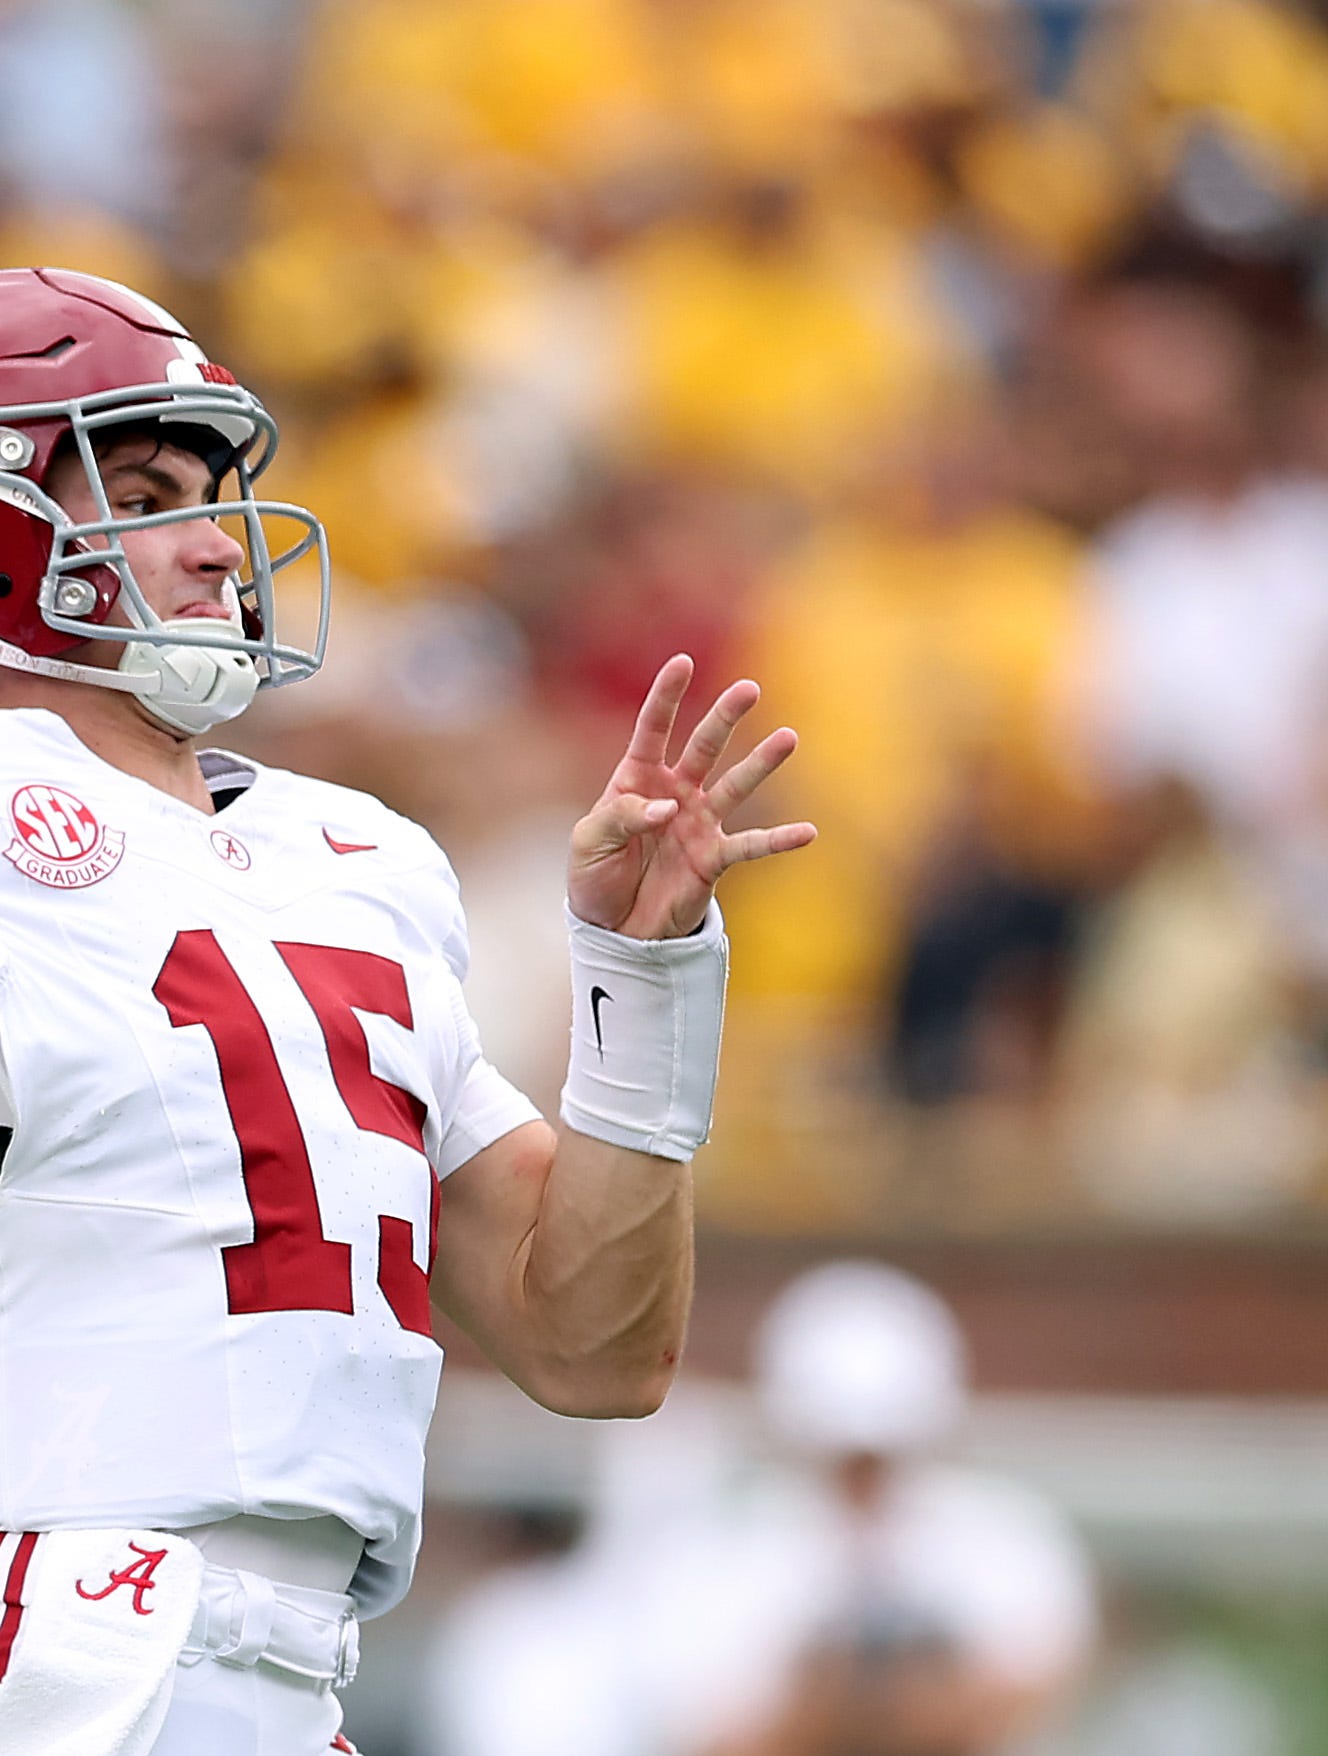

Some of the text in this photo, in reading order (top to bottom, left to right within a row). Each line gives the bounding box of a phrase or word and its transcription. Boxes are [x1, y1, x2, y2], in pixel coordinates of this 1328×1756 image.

[12, 786, 99, 860] SEC
[26, 845, 119, 885] GRADUATE
[151, 928, 441, 1337] 15
[75, 1540, 168, 1615] A
